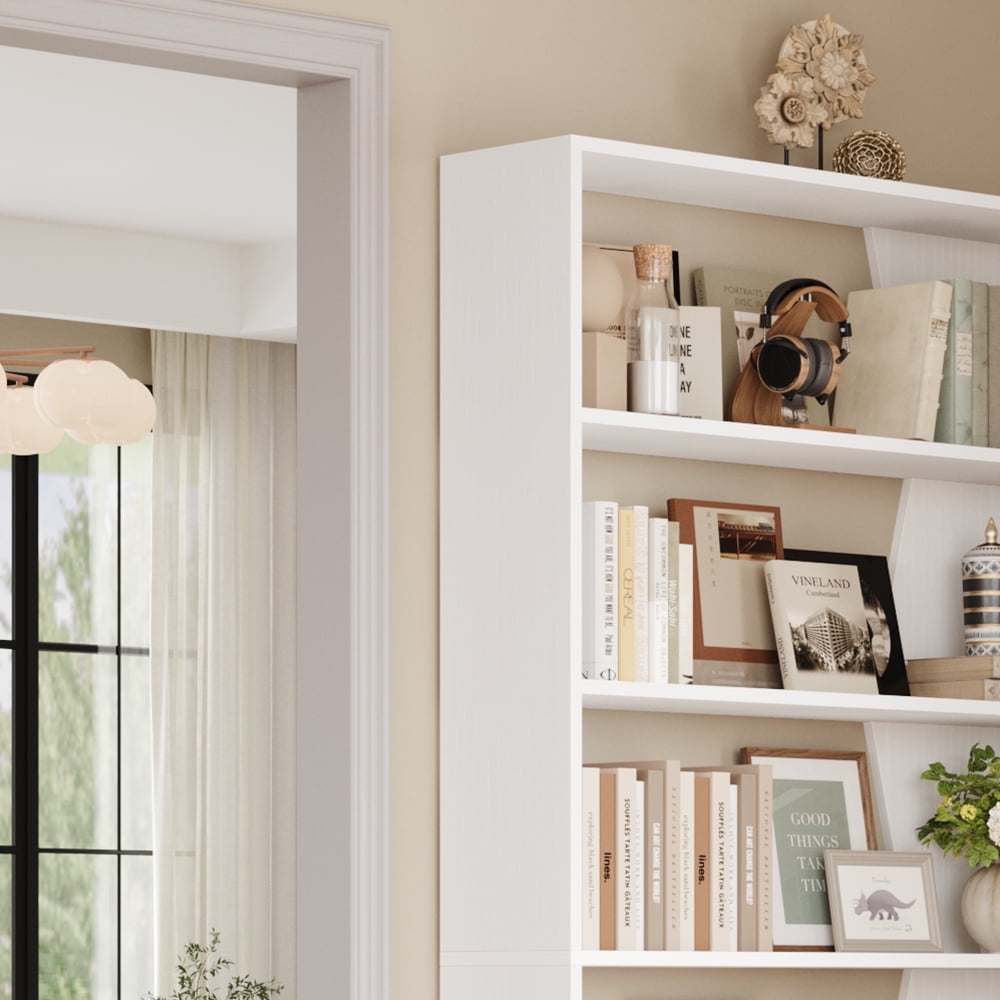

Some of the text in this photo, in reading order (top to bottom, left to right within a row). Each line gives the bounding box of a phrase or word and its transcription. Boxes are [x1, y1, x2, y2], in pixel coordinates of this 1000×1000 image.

[679, 380, 692, 394] AY
[791, 574, 851, 591] VINELAND
[622, 567, 633, 627] CEREAL
[790, 811, 831, 827] GOOD
[786, 833, 840, 849] THINGS
[603, 851, 612, 884] lines.
[698, 854, 707, 886] lines.
[796, 855, 826, 870] TAK
[800, 878, 826, 893] TIM
